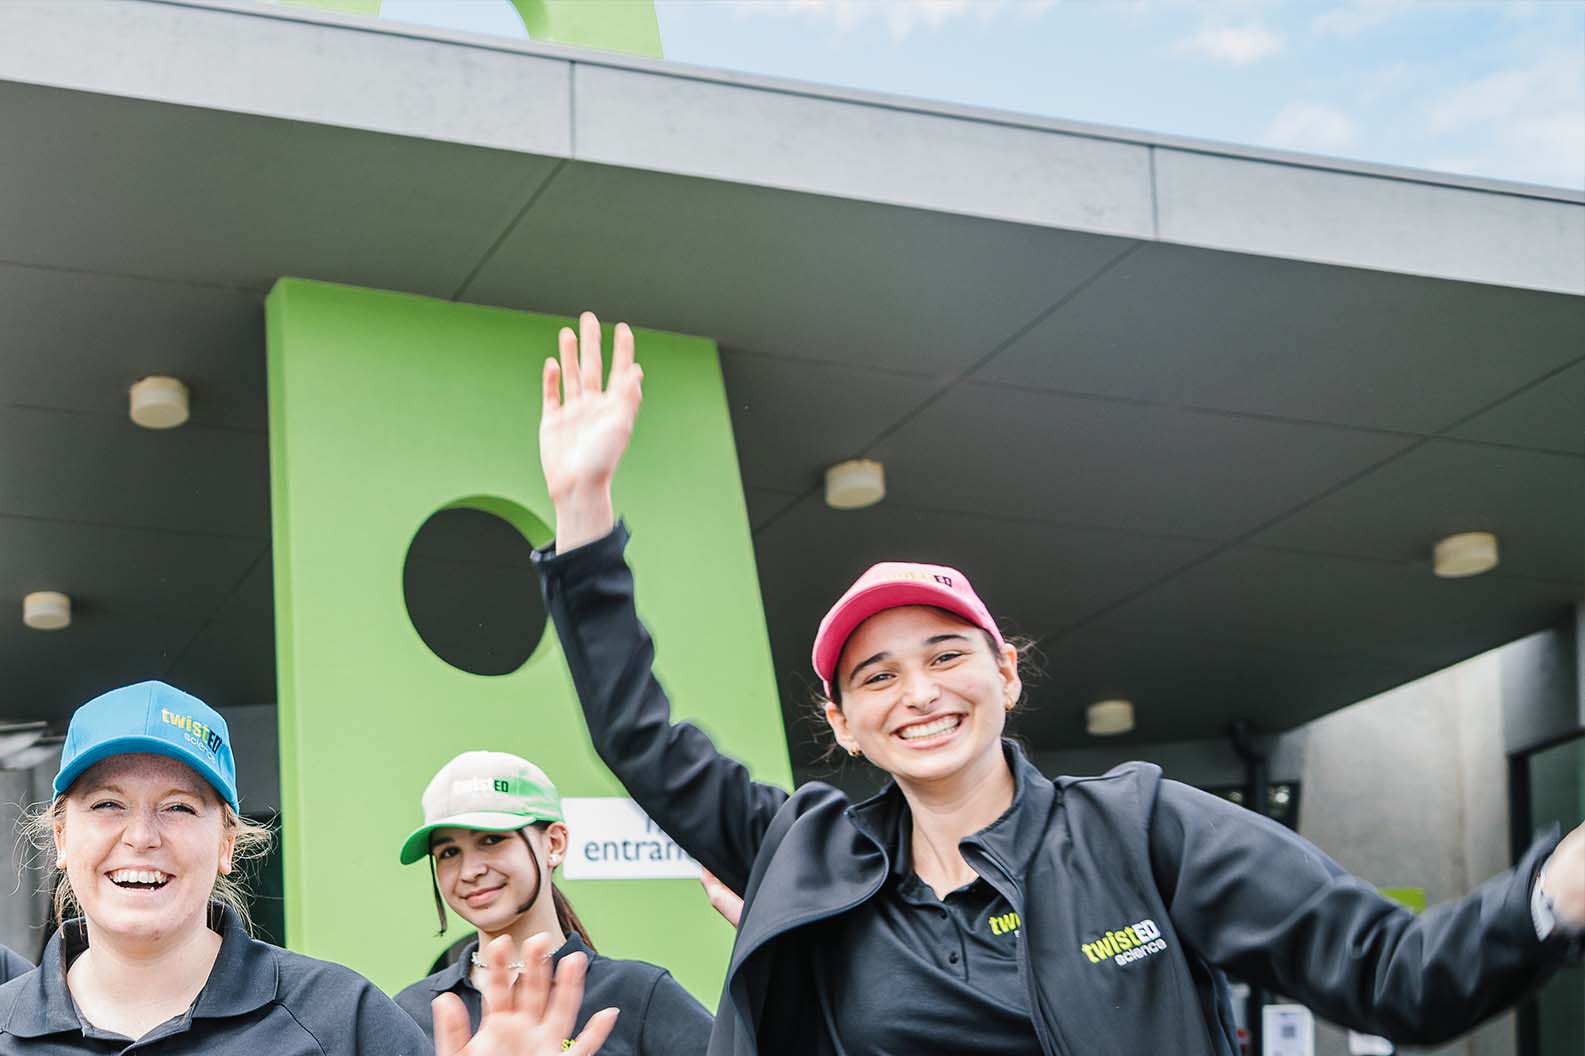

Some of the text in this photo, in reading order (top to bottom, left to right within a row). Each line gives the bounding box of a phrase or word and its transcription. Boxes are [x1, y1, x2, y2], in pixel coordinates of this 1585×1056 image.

[161, 708, 223, 754] twistED
[584, 840, 682, 862] entran
[1081, 919, 1162, 964] twistED
[1115, 938, 1167, 967] science
